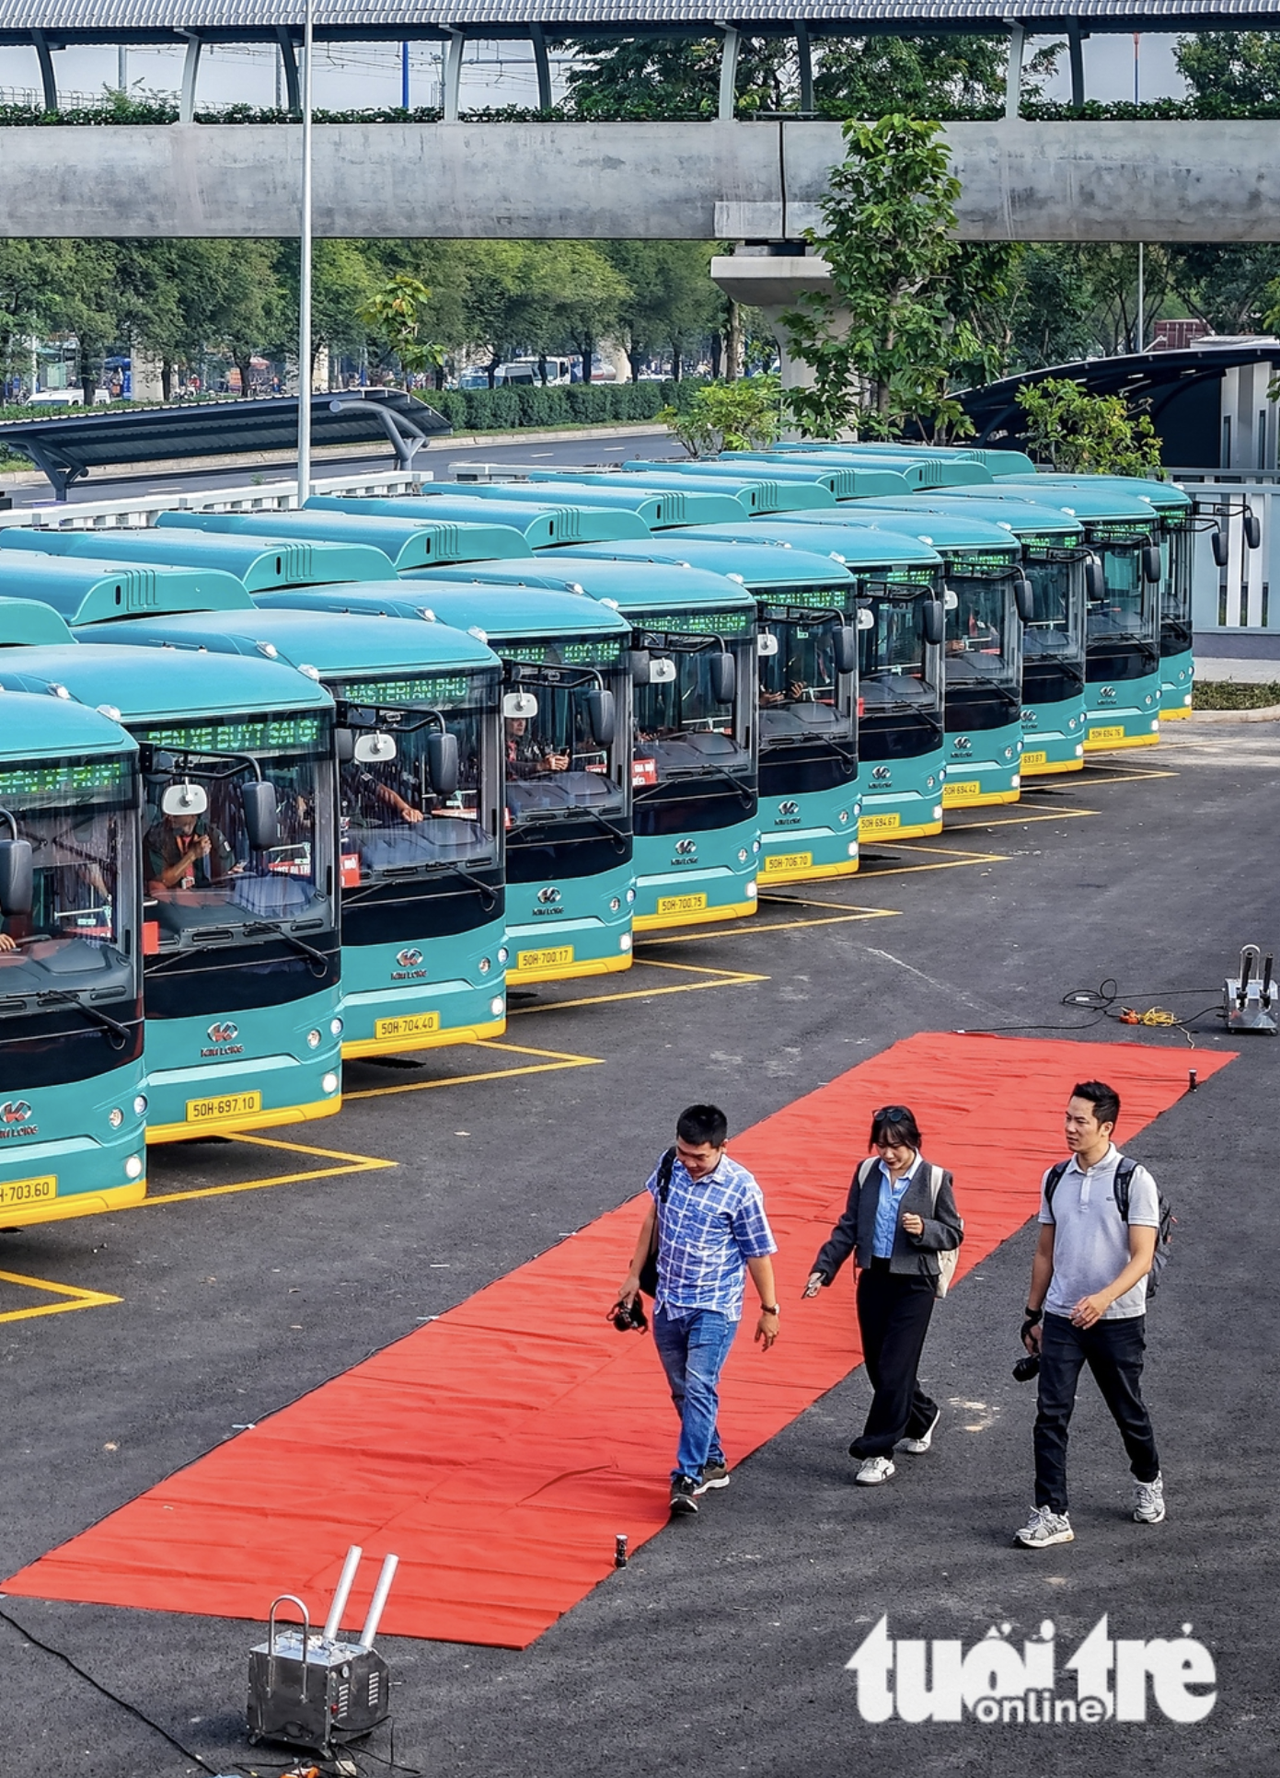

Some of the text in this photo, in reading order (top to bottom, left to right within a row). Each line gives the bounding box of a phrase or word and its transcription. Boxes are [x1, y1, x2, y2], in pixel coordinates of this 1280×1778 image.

[522, 949, 569, 967] 50H-700.17
[380, 1017, 435, 1037] 50H-704.40
[192, 1096, 256, 1119] 50H-697.10
